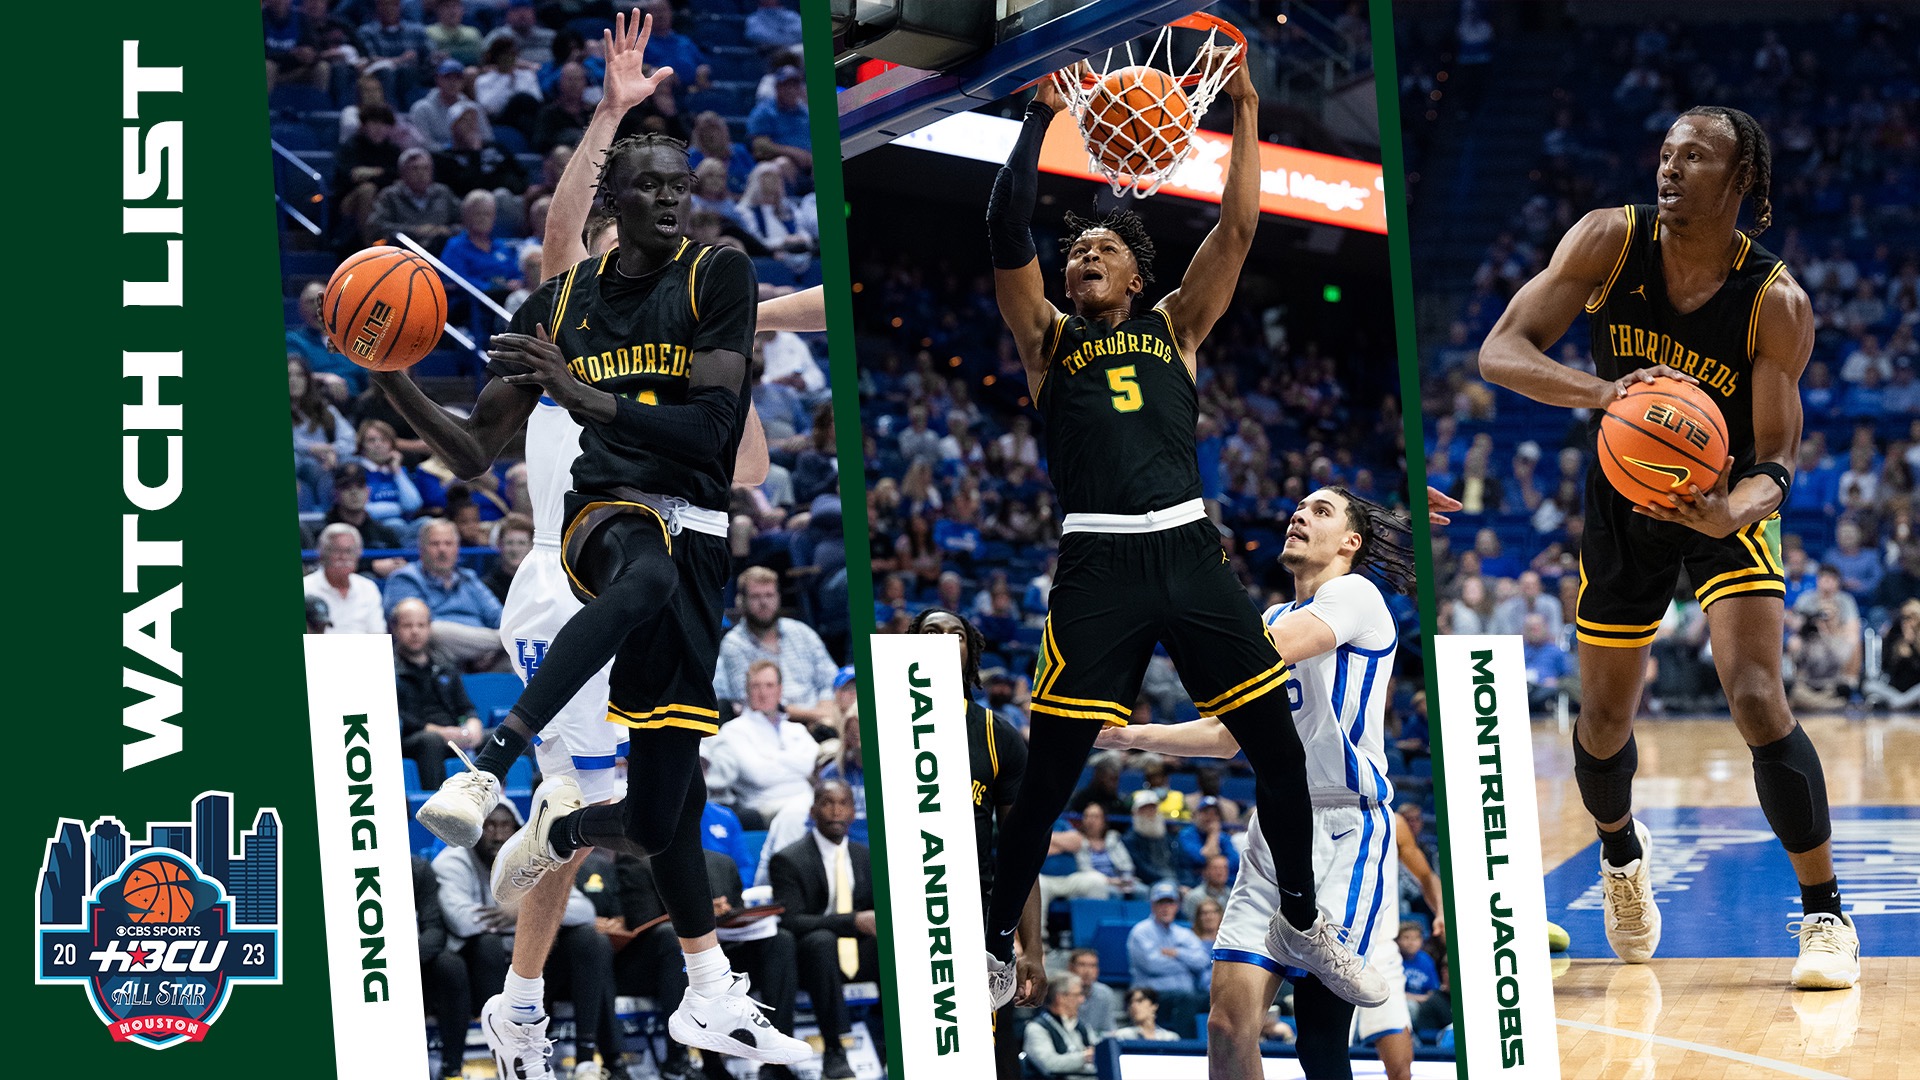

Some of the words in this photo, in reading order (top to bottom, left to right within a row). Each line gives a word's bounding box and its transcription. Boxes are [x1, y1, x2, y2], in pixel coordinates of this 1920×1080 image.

[351, 299, 392, 359] ELITE
[1610, 324, 1740, 397] THOROBREDS
[1105, 364, 1145, 413] 5
[1644, 403, 1711, 451] ELITE
